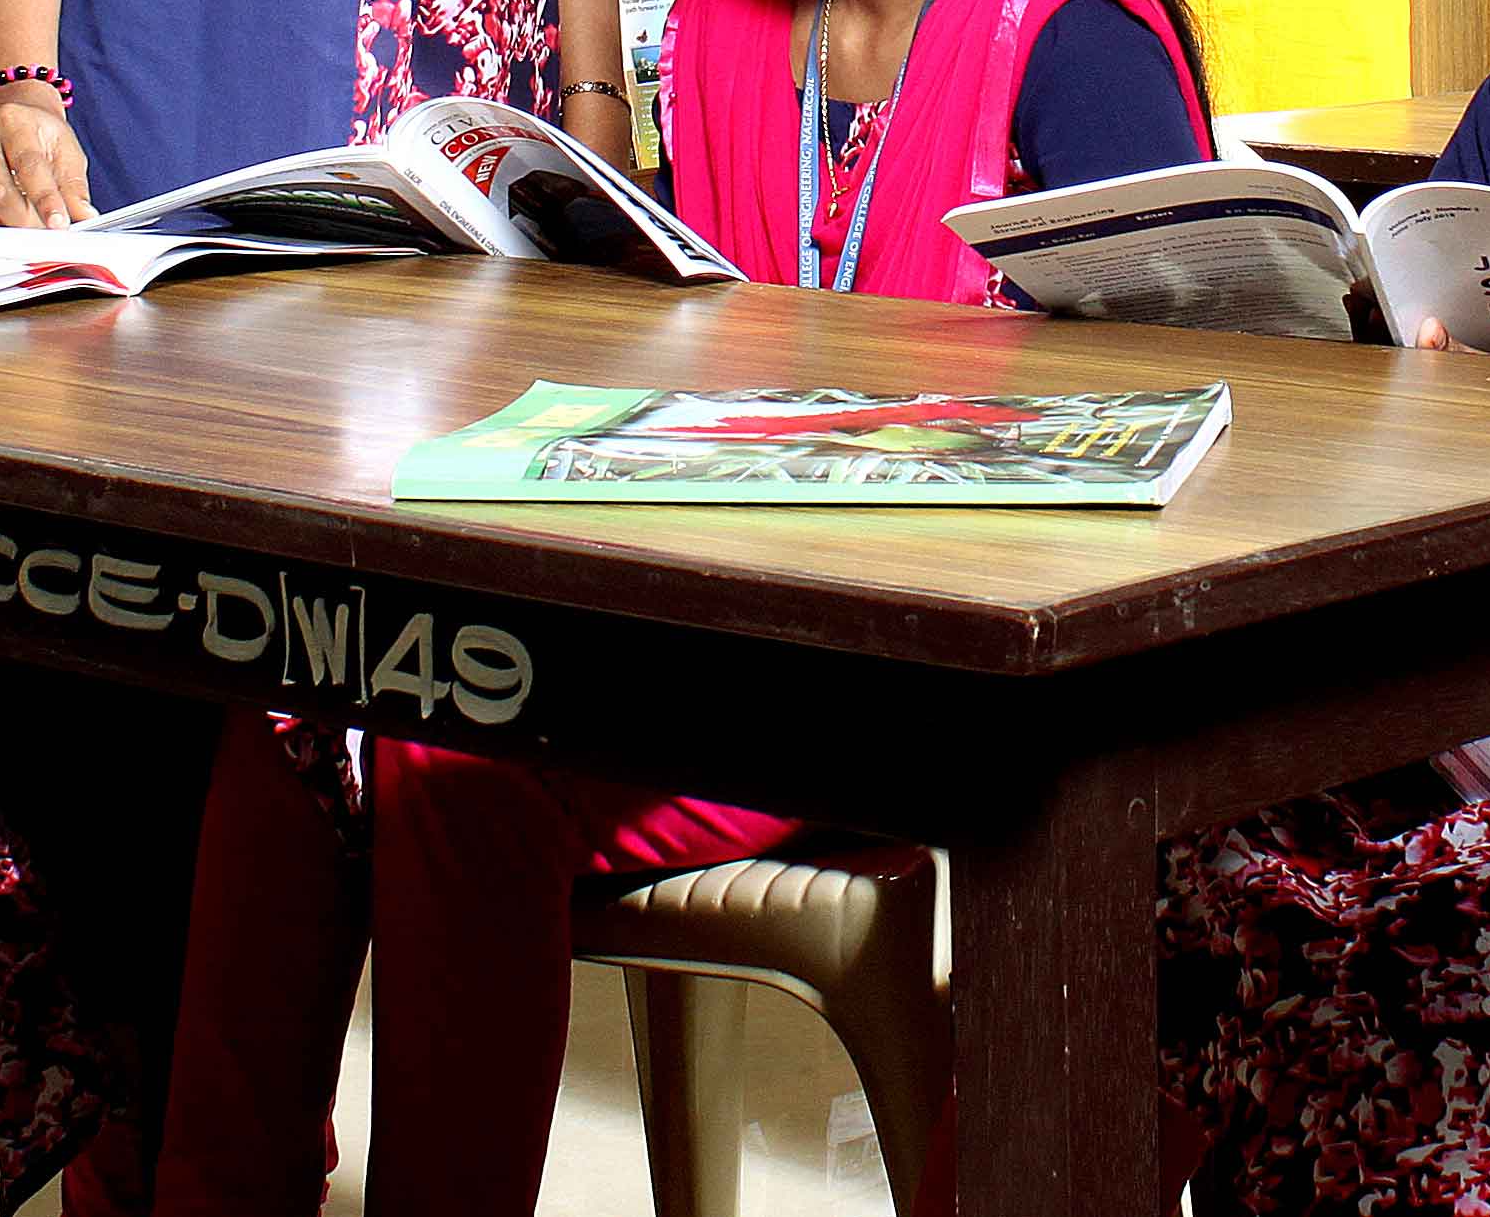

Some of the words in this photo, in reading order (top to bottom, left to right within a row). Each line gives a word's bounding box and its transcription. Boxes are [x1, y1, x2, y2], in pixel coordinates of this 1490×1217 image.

[801, 77, 815, 144] NAGERCOIL
[474, 154, 499, 184] NEW
[799, 146, 814, 227] ENGINEERING,
[850, 184, 874, 239] COLLEGE
[993, 220, 1049, 235] Structural
[1051, 207, 1115, 225] Engineering
[801, 230, 812, 246] OF
[846, 240, 860, 259] OF
[800, 250, 813, 287] OLLEGE
